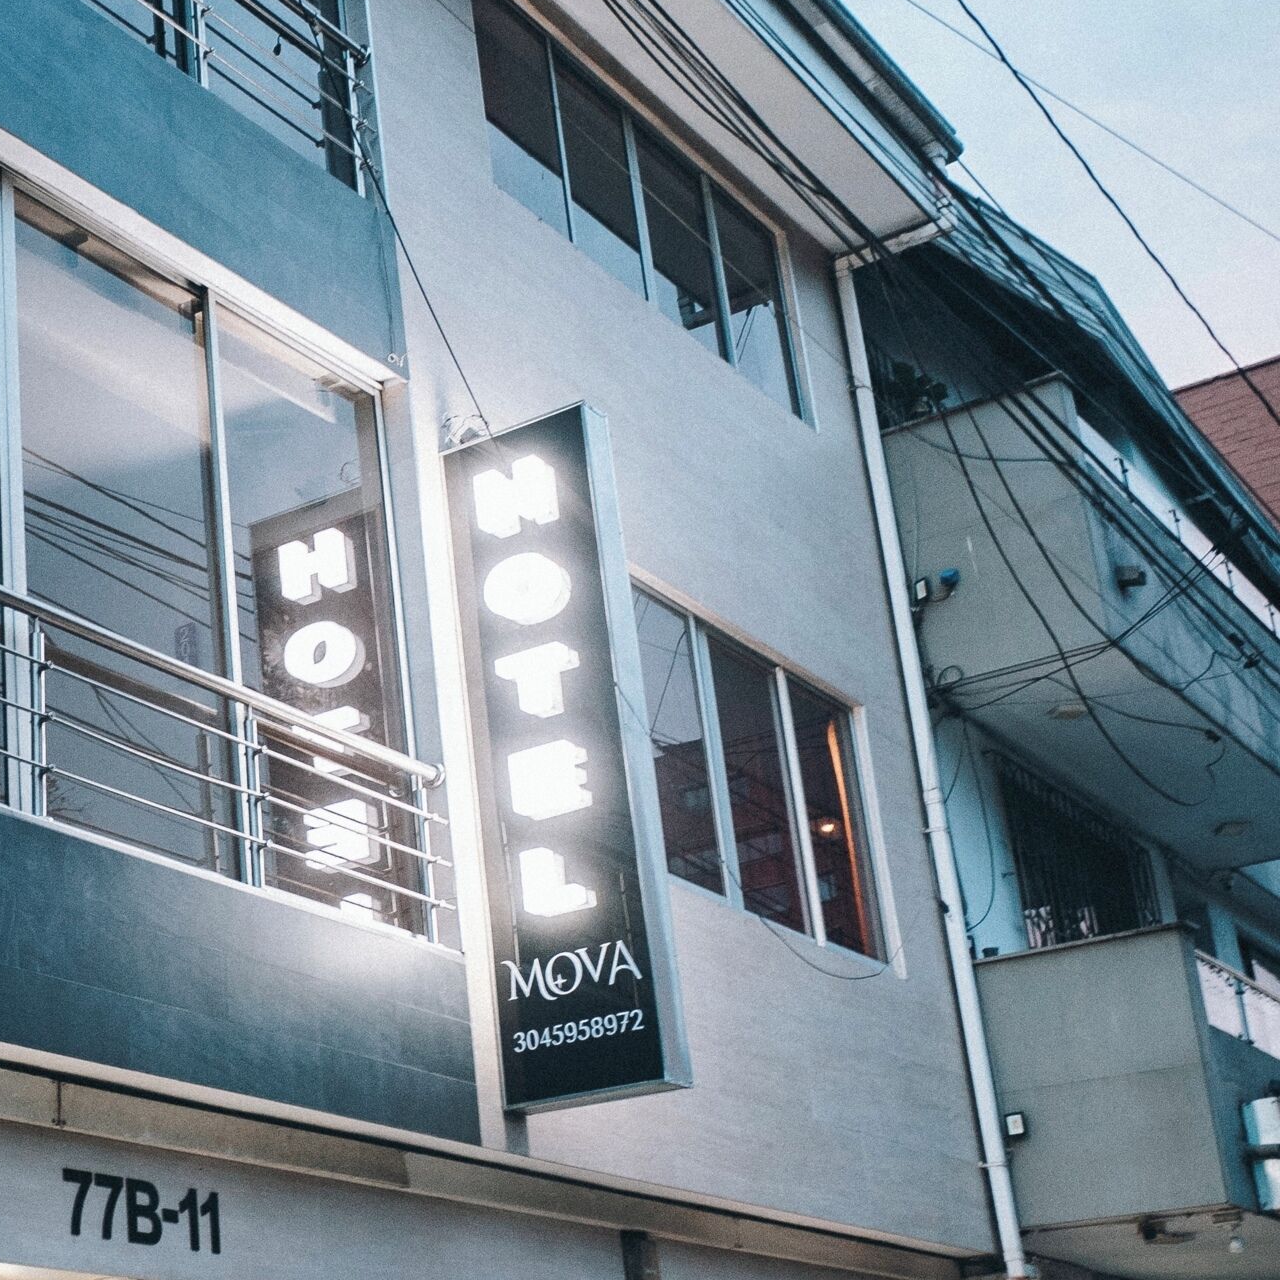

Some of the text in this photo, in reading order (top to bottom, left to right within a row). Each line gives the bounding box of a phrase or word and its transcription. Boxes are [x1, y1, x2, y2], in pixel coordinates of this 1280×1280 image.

[473, 453, 597, 917] HOTEL
[500, 939, 644, 1002] MOVA
[513, 1009, 645, 1053] 3045958972
[62, 1168, 221, 1255] 77B-11
